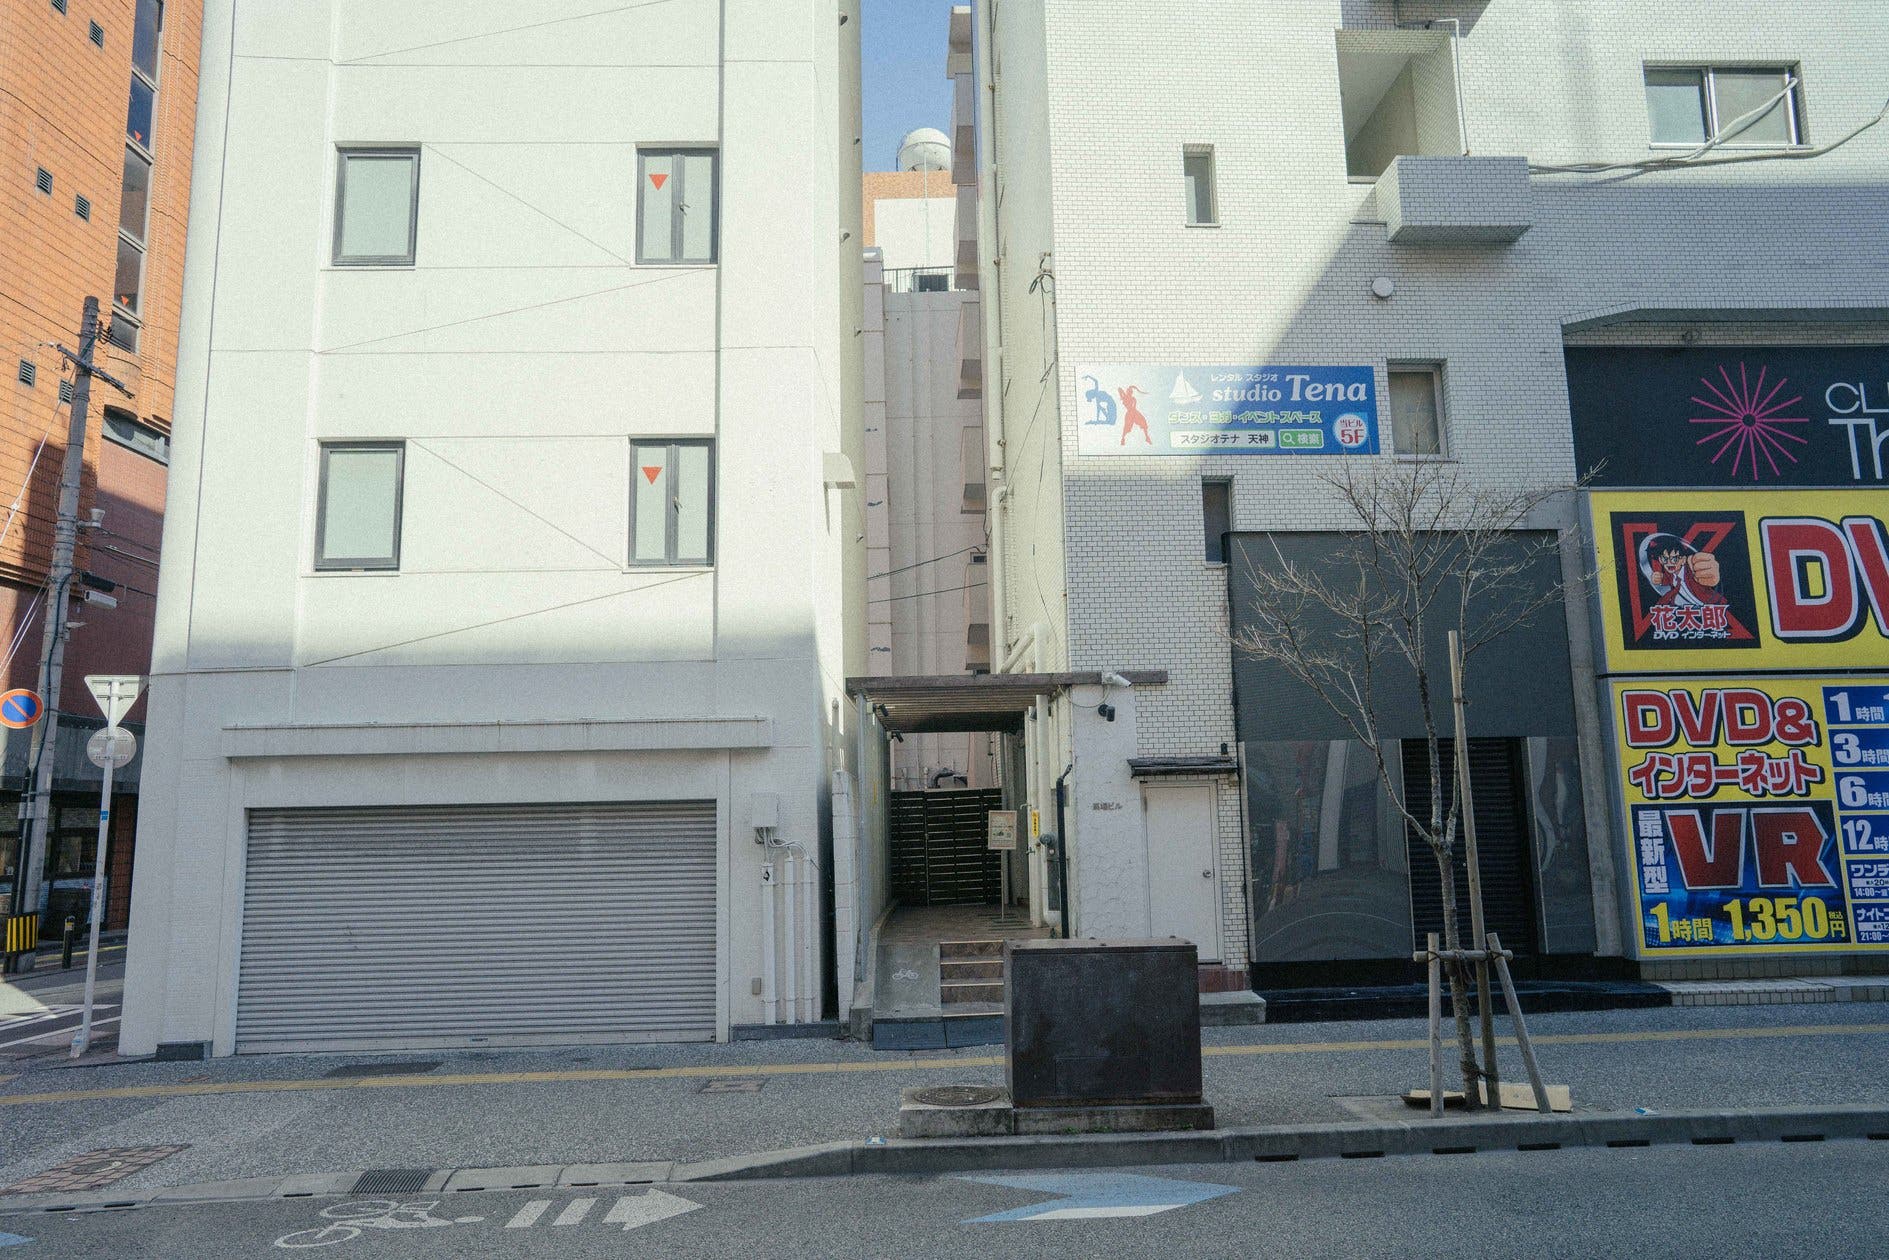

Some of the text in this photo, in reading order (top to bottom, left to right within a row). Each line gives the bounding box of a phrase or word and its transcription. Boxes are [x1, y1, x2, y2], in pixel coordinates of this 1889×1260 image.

[1211, 373, 1278, 382] レンタル スタジオ
[1212, 375, 1367, 402] studio Tena
[1340, 419, 1363, 428] 当ビル
[1341, 428, 1364, 444] 5F
[1180, 433, 1320, 444] スタジオテナ 天神 検索
[1650, 604, 1729, 631] 花太郎
[1653, 631, 1732, 640] DVD インターネット
[1622, 688, 1820, 746] DVD&
[1629, 750, 1823, 797] インターネット
[1638, 810, 1670, 894] 最新型
[1664, 810, 1838, 889] VR
